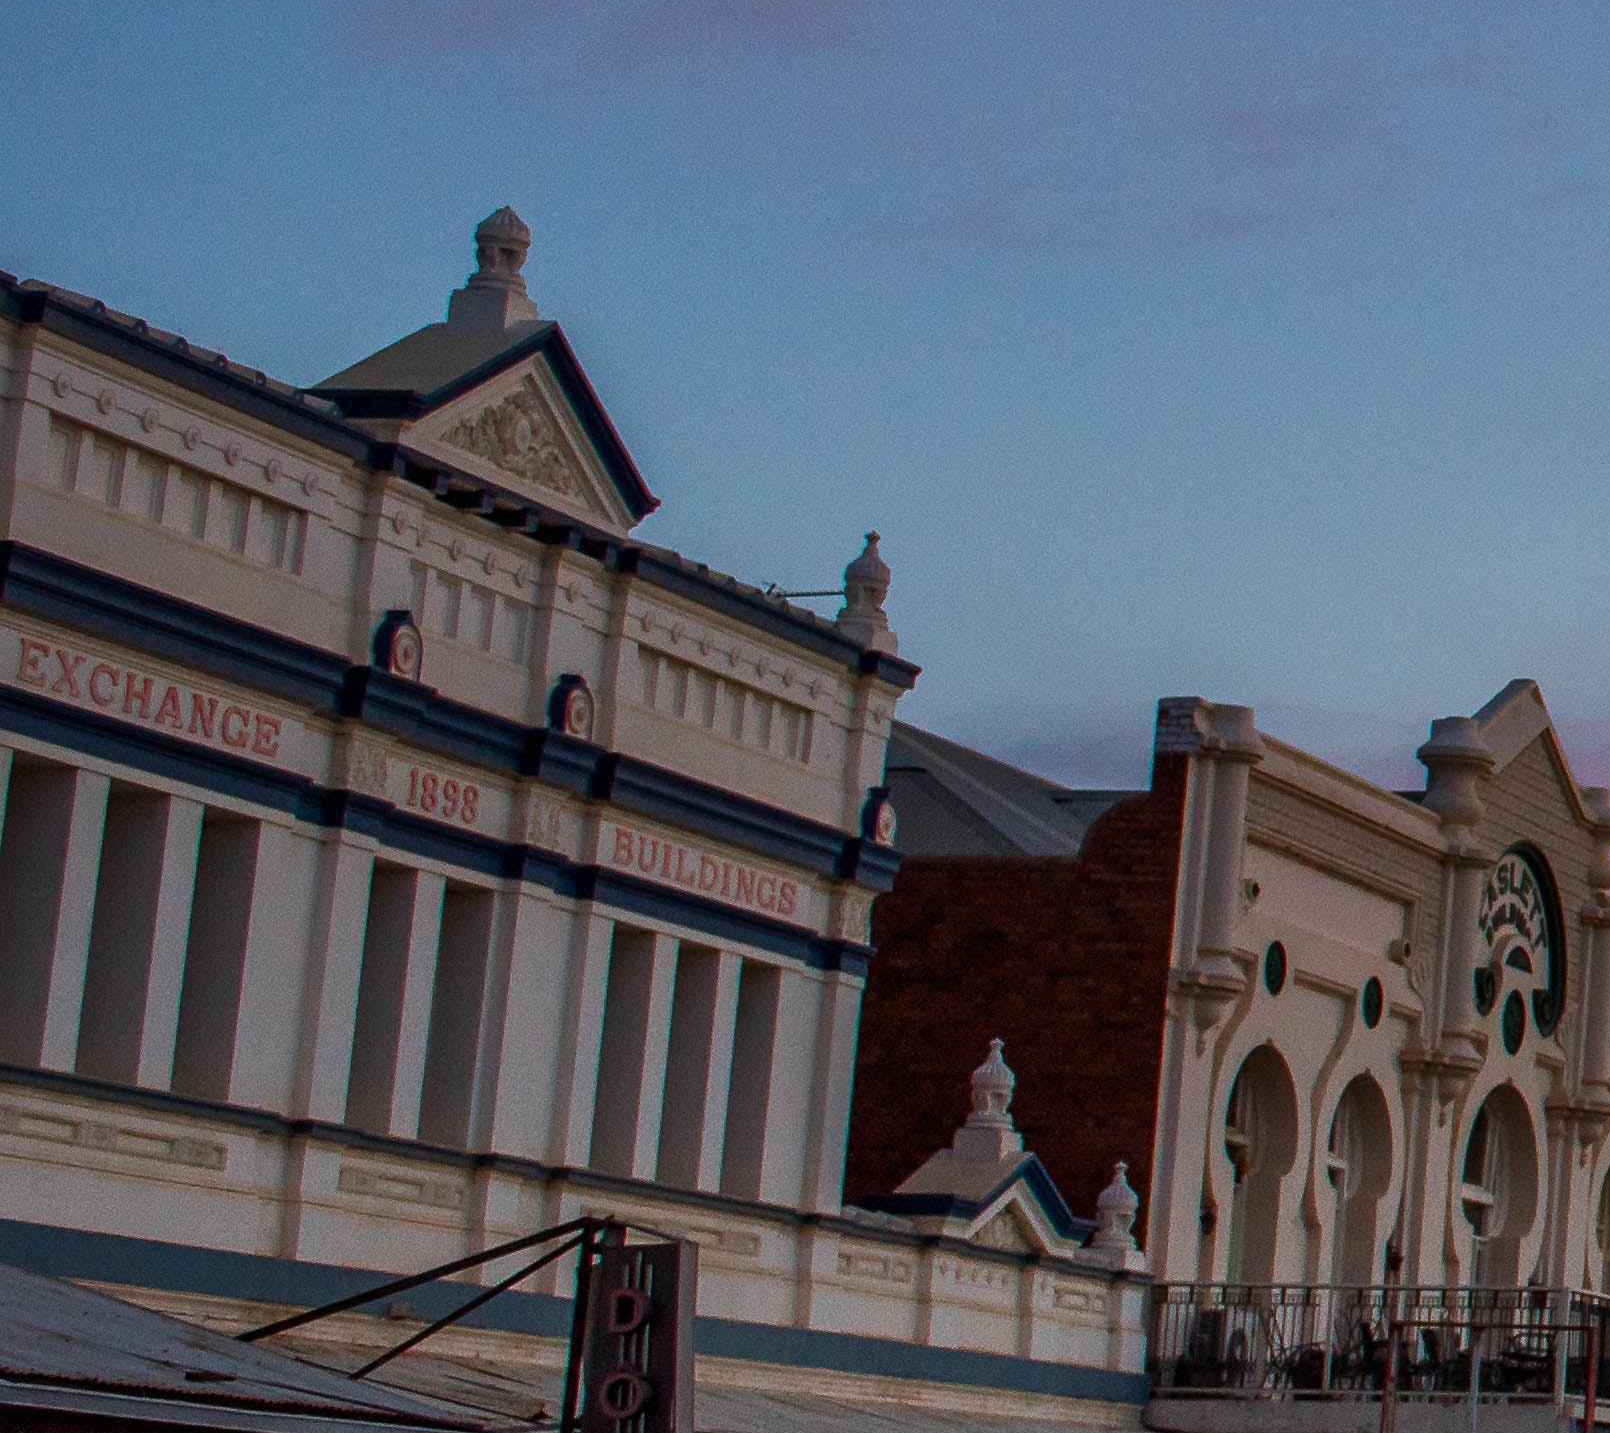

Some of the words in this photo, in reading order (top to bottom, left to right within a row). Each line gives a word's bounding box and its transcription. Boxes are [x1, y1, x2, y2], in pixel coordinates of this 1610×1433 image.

[15, 637, 282, 759] EXCHANGE
[406, 767, 481, 824] 1898
[613, 827, 799, 916] BUILDINGS
